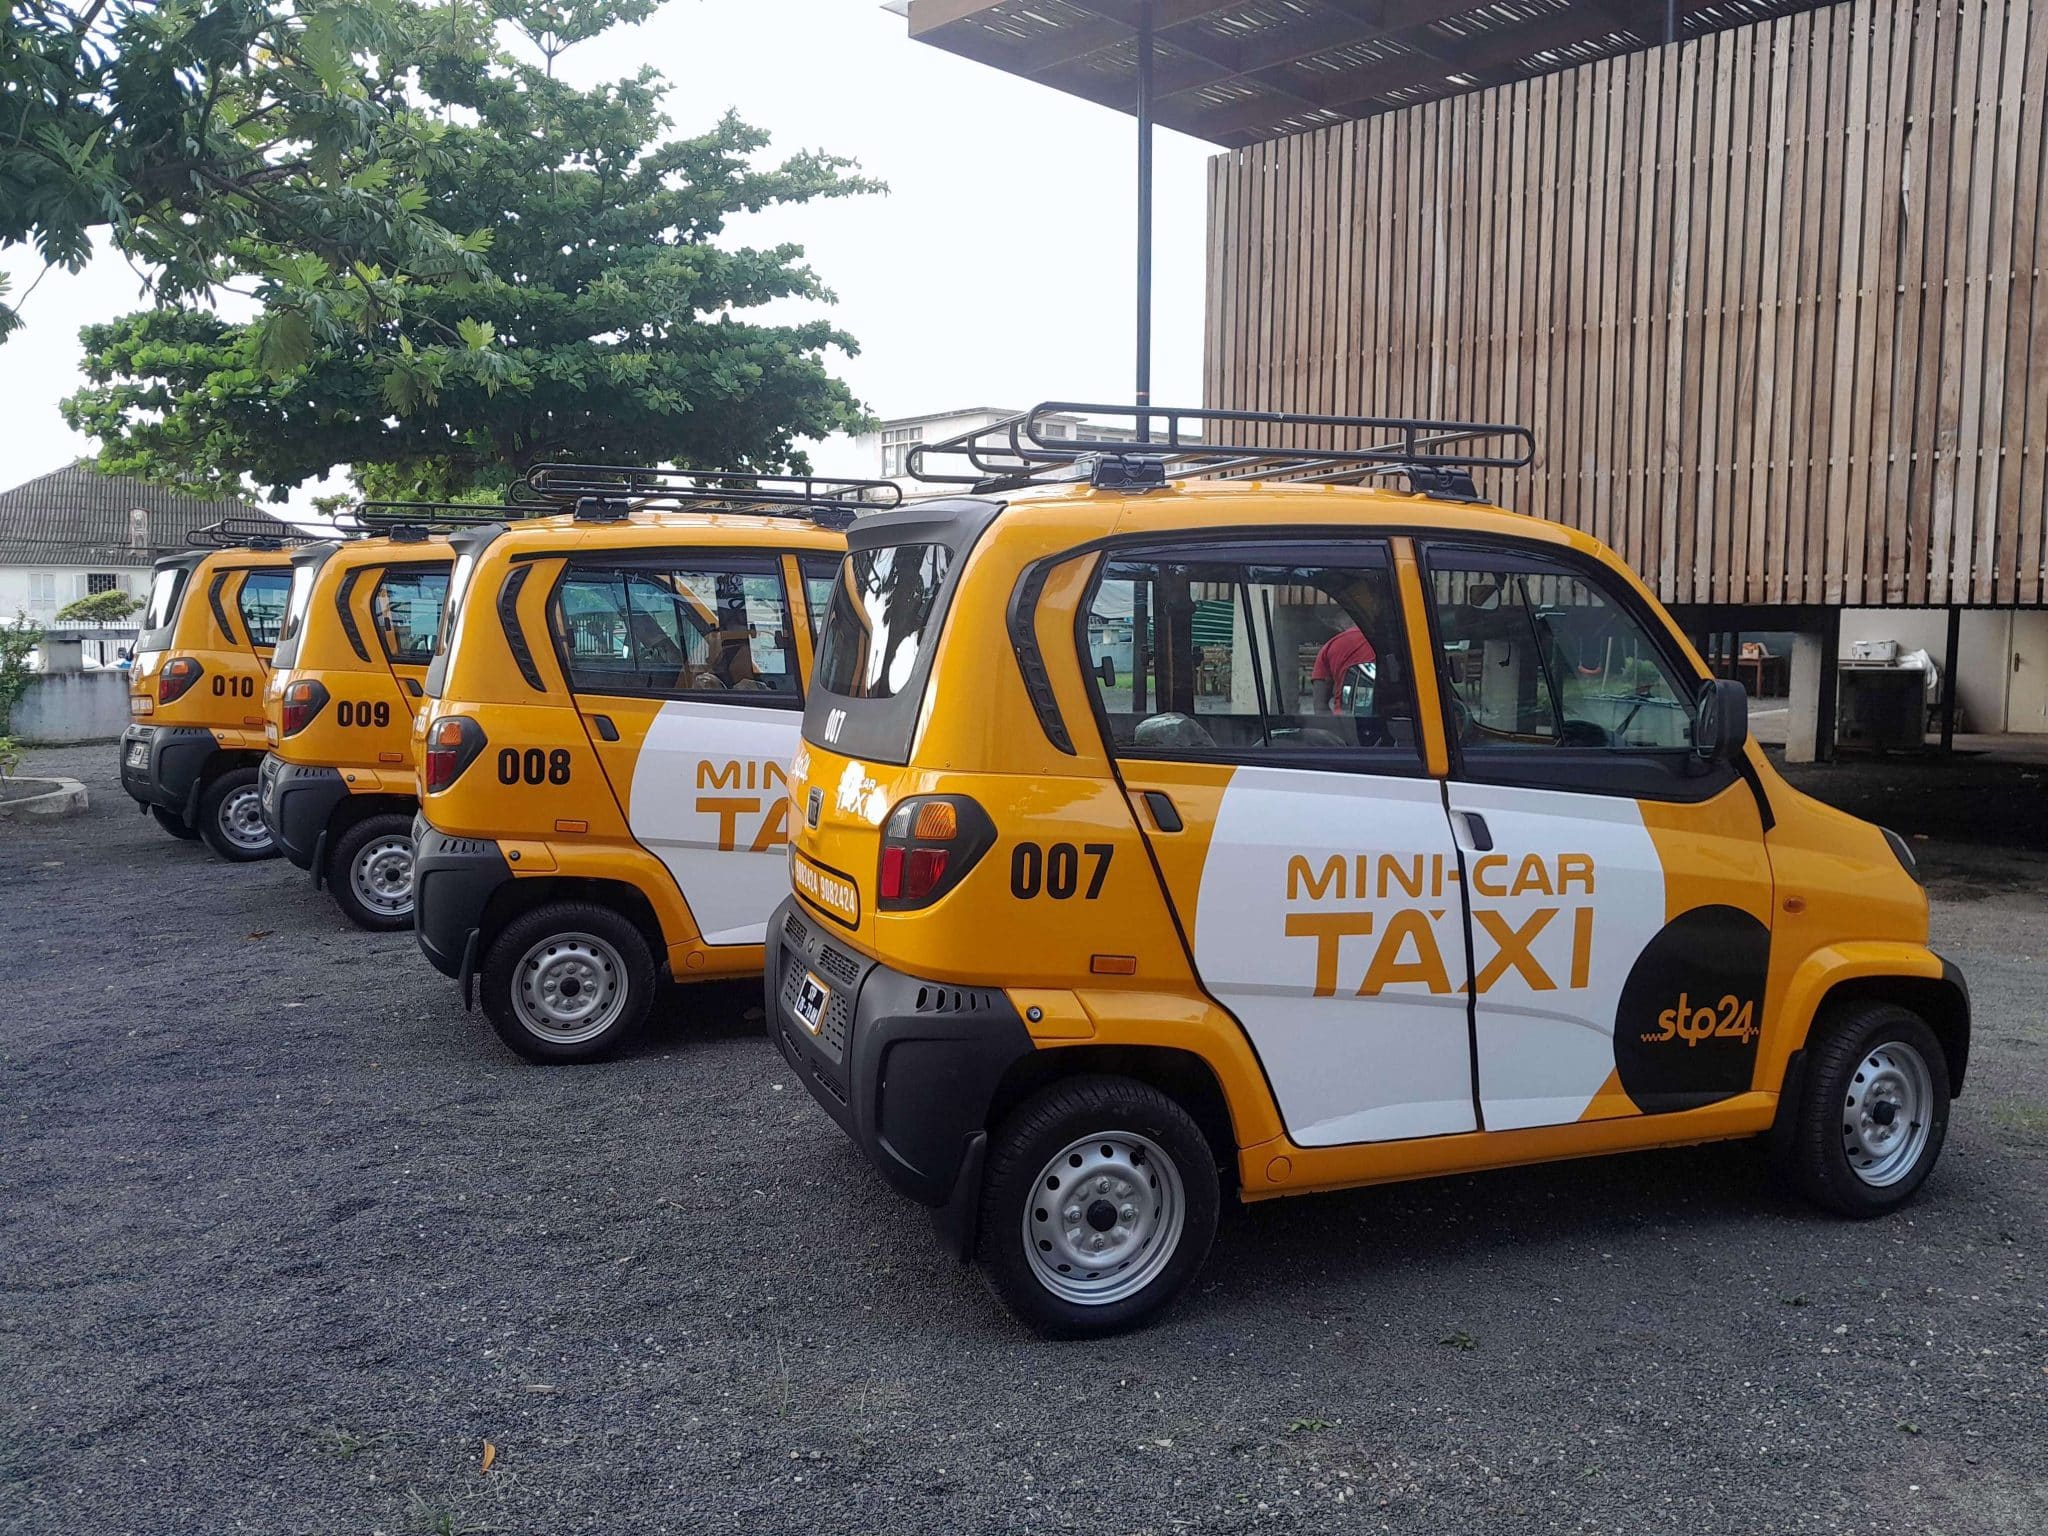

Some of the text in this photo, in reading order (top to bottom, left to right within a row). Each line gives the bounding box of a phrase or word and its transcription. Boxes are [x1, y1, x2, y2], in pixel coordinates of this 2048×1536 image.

[212, 674, 254, 698] 010
[337, 700, 390, 728] 009
[824, 708, 847, 744] 007
[498, 748, 571, 785] 008
[1010, 841, 1114, 900] 007
[1286, 852, 1595, 900] MINI-CAR
[820, 875, 856, 915] 9082424
[1284, 906, 1594, 997] TAXI
